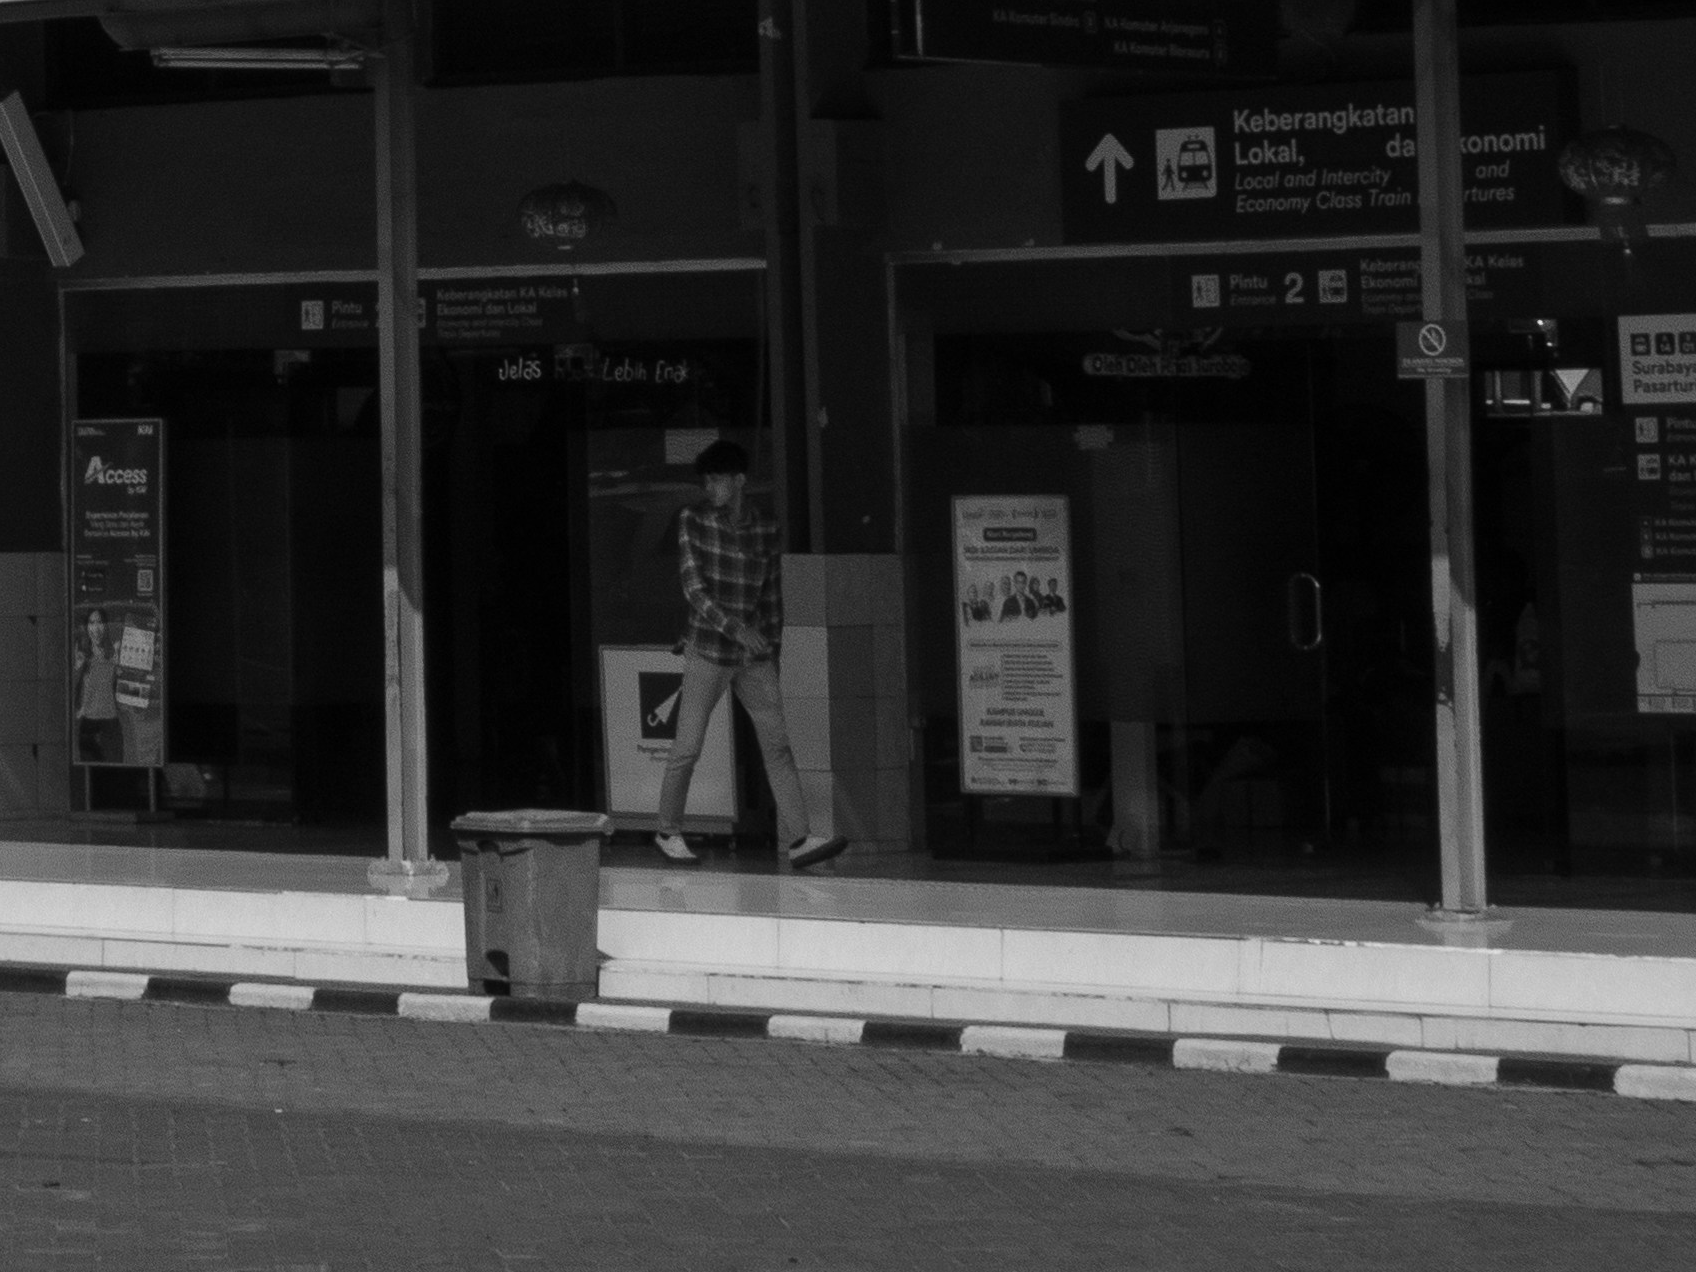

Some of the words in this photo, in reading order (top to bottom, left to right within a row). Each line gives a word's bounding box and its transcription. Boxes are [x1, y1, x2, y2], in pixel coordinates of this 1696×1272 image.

[1234, 105, 1415, 135] Keberangkatan
[1235, 139, 1305, 166] Lokal,
[1386, 133, 1416, 159] da
[1461, 125, 1546, 156] konomi
[1235, 173, 1279, 190] Local
[1283, 173, 1314, 188] and
[1321, 165, 1391, 187] Intercity
[1475, 161, 1509, 179] and
[1236, 196, 1309, 216] Economy
[1316, 192, 1362, 210] Class
[1369, 189, 1411, 206] Train
[1463, 186, 1515, 202] rtures
[1360, 259, 1421, 274] Keberang
[1488, 255, 1524, 268] Kelas
[1230, 275, 1268, 290] Pintu
[1284, 272, 1304, 303] 2
[1361, 276, 1418, 289] Ekonomi
[437, 290, 517, 302] Keberangkatan
[520, 288, 535, 298] KA
[538, 288, 568, 298] Kelas
[331, 301, 362, 314] Pintu
[437, 304, 482, 316] Ekonomi
[485, 303, 505, 315] dan
[509, 302, 536, 314] Lokal
[602, 357, 647, 381] Lebih
[1633, 379, 1696, 393] Pasartur
[84, 455, 147, 485] Access
